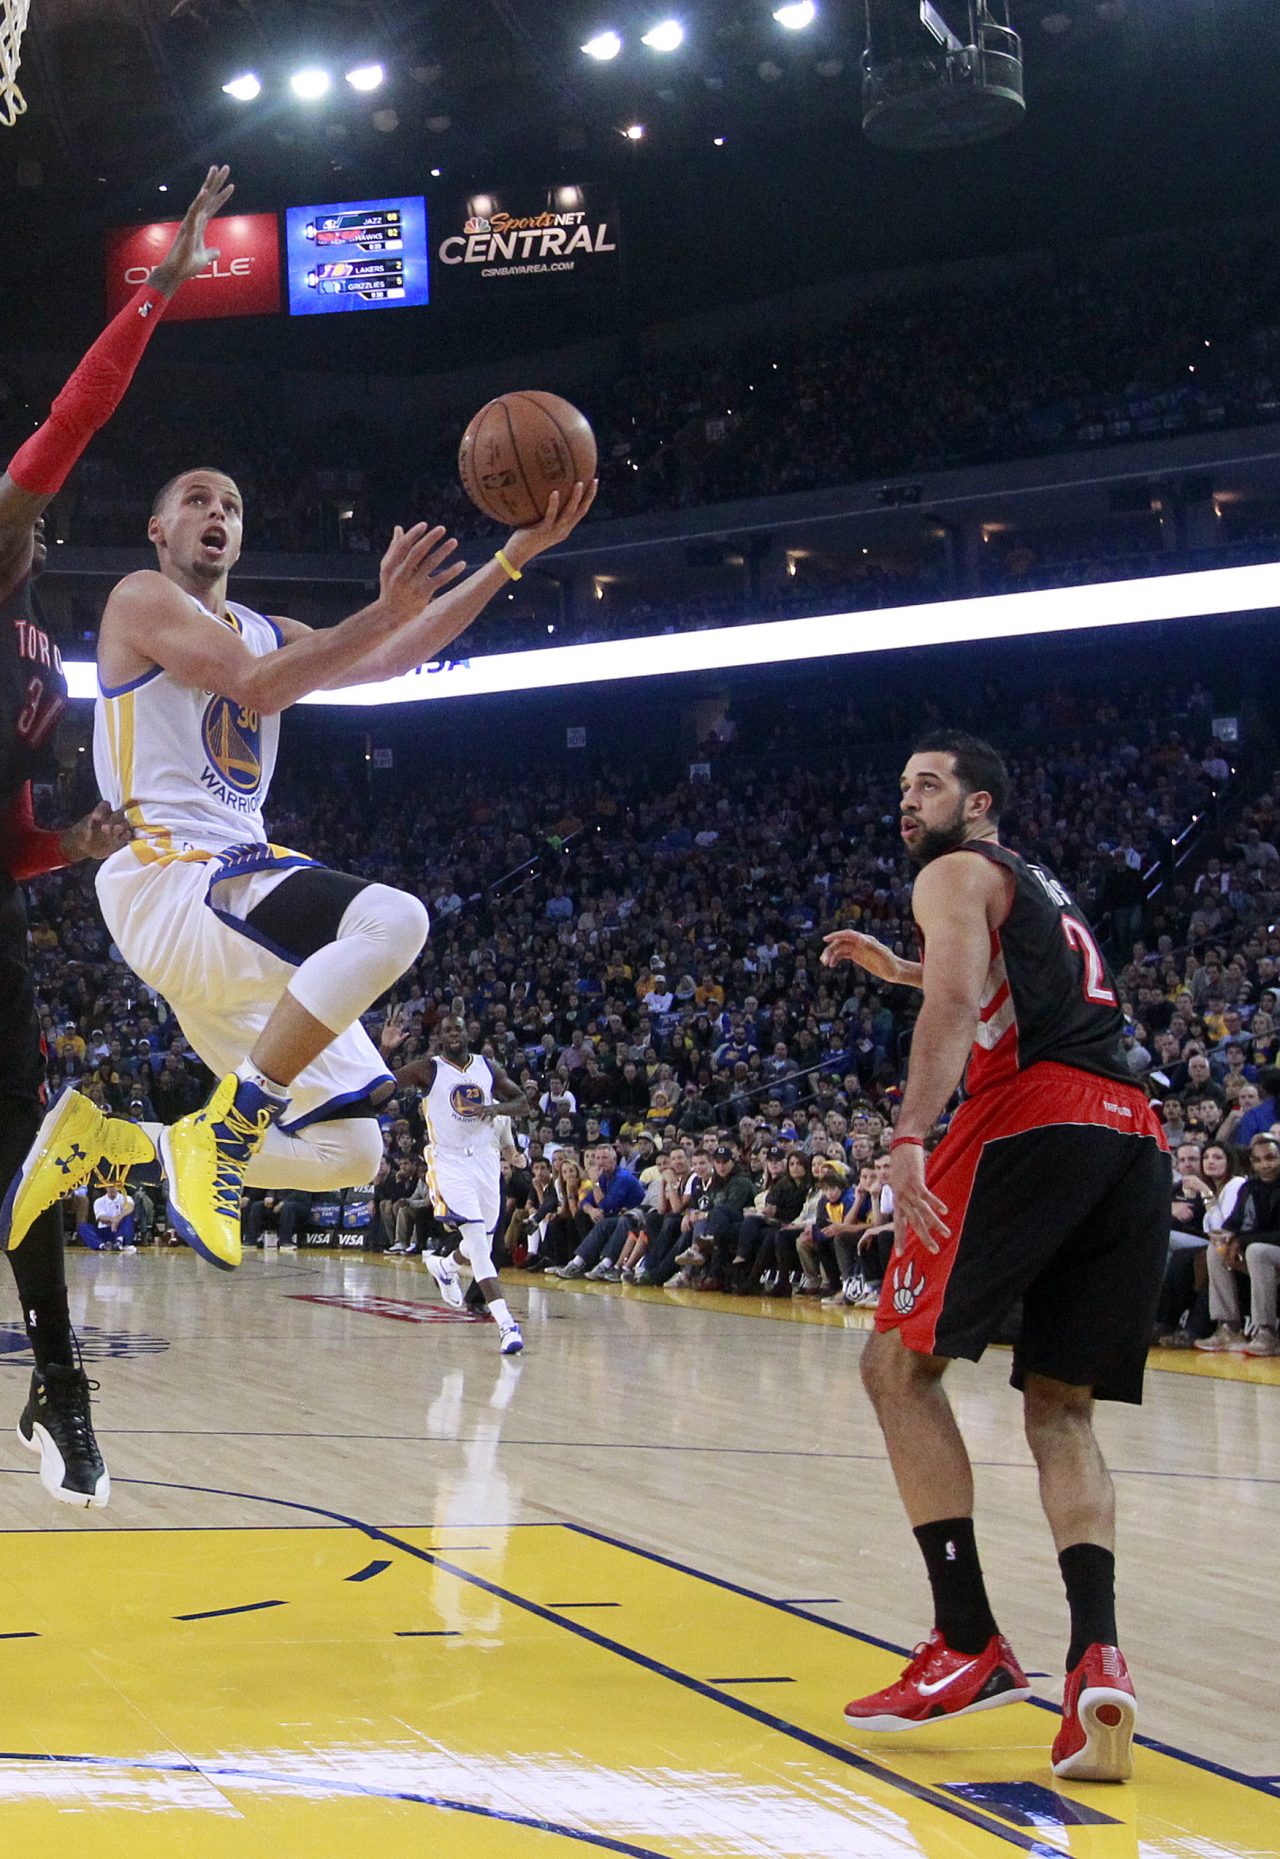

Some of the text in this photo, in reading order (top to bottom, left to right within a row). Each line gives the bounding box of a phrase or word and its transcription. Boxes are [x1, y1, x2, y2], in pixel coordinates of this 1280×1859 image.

[362, 216, 383, 225] JAZZ
[438, 223, 617, 265] CENTRAL
[124, 258, 251, 285] OLE
[355, 265, 385, 274] LAKERS
[481, 261, 575, 278] CSNBAYAREA.COM
[348, 280, 386, 291] GRIZZLIES
[14, 619, 63, 676] TORO
[236, 703, 259, 733] 30
[1060, 913, 1118, 1008] 2
[466, 1088, 480, 1099] 23
[353, 1184, 375, 1194] VISA
[306, 1233, 331, 1244] VISA
[338, 1234, 364, 1246] VISA
